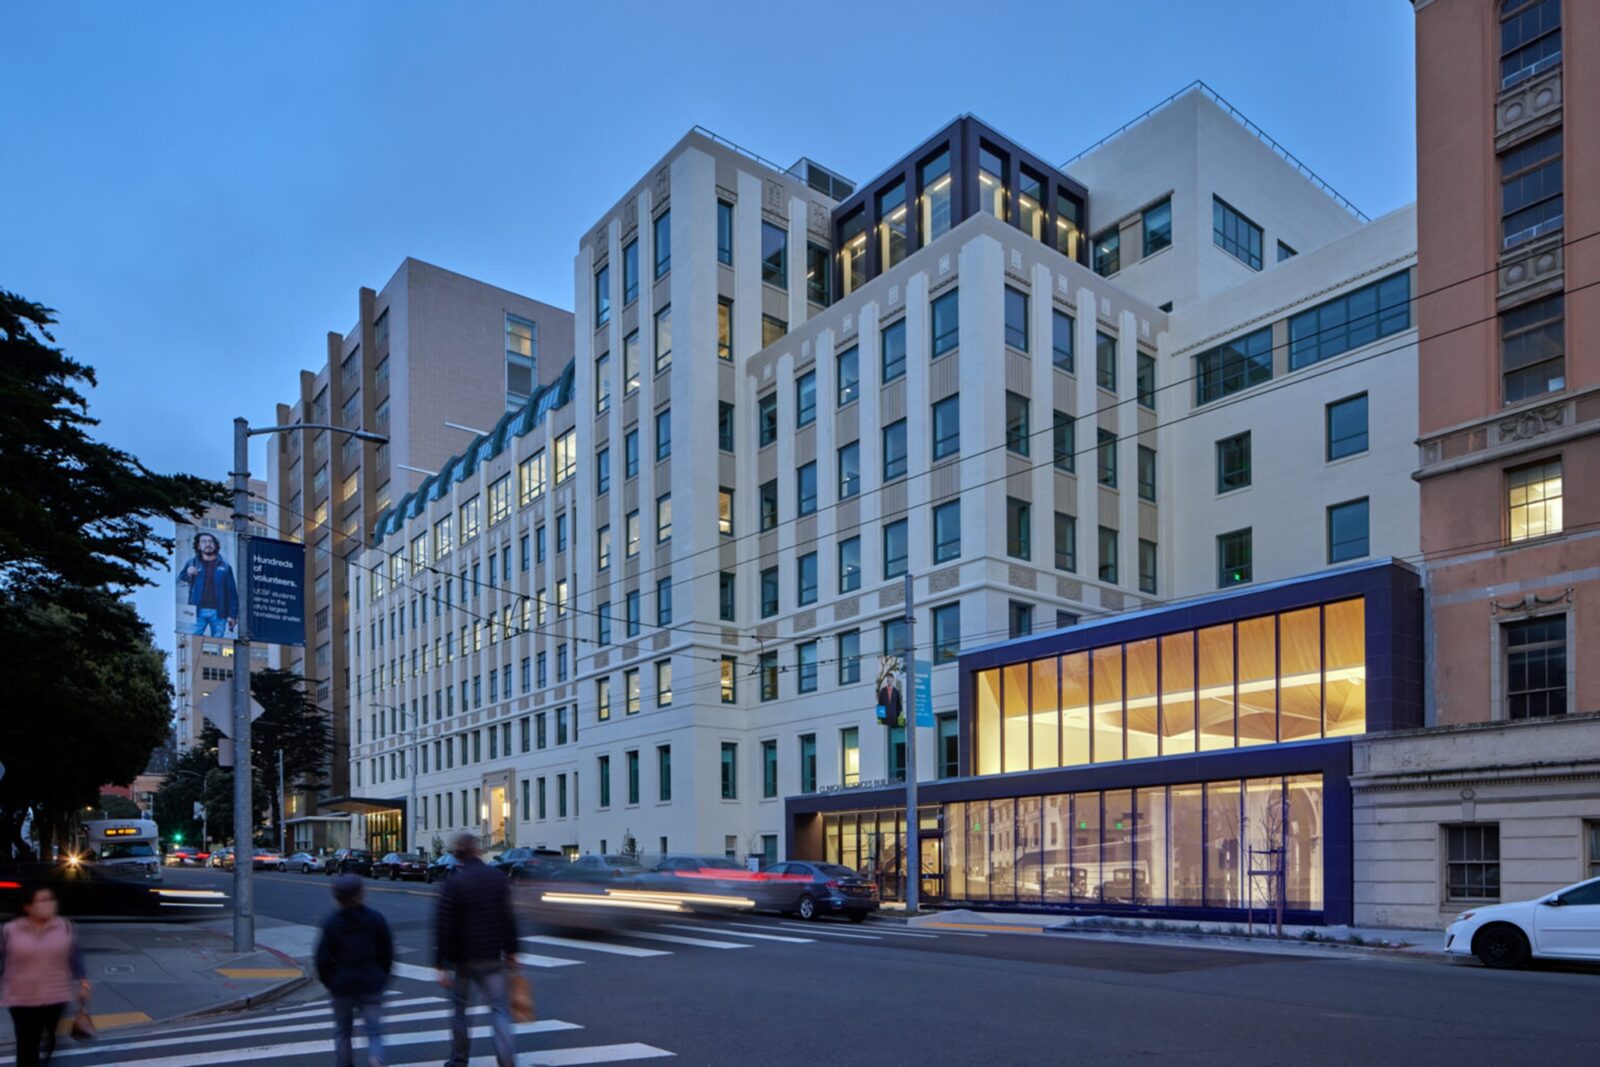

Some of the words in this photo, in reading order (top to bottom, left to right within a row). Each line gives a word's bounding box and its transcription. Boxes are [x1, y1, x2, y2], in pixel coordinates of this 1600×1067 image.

[253, 554, 293, 568] Hundreds
[253, 564, 262, 572] of
[253, 574, 297, 587] volunteers.
